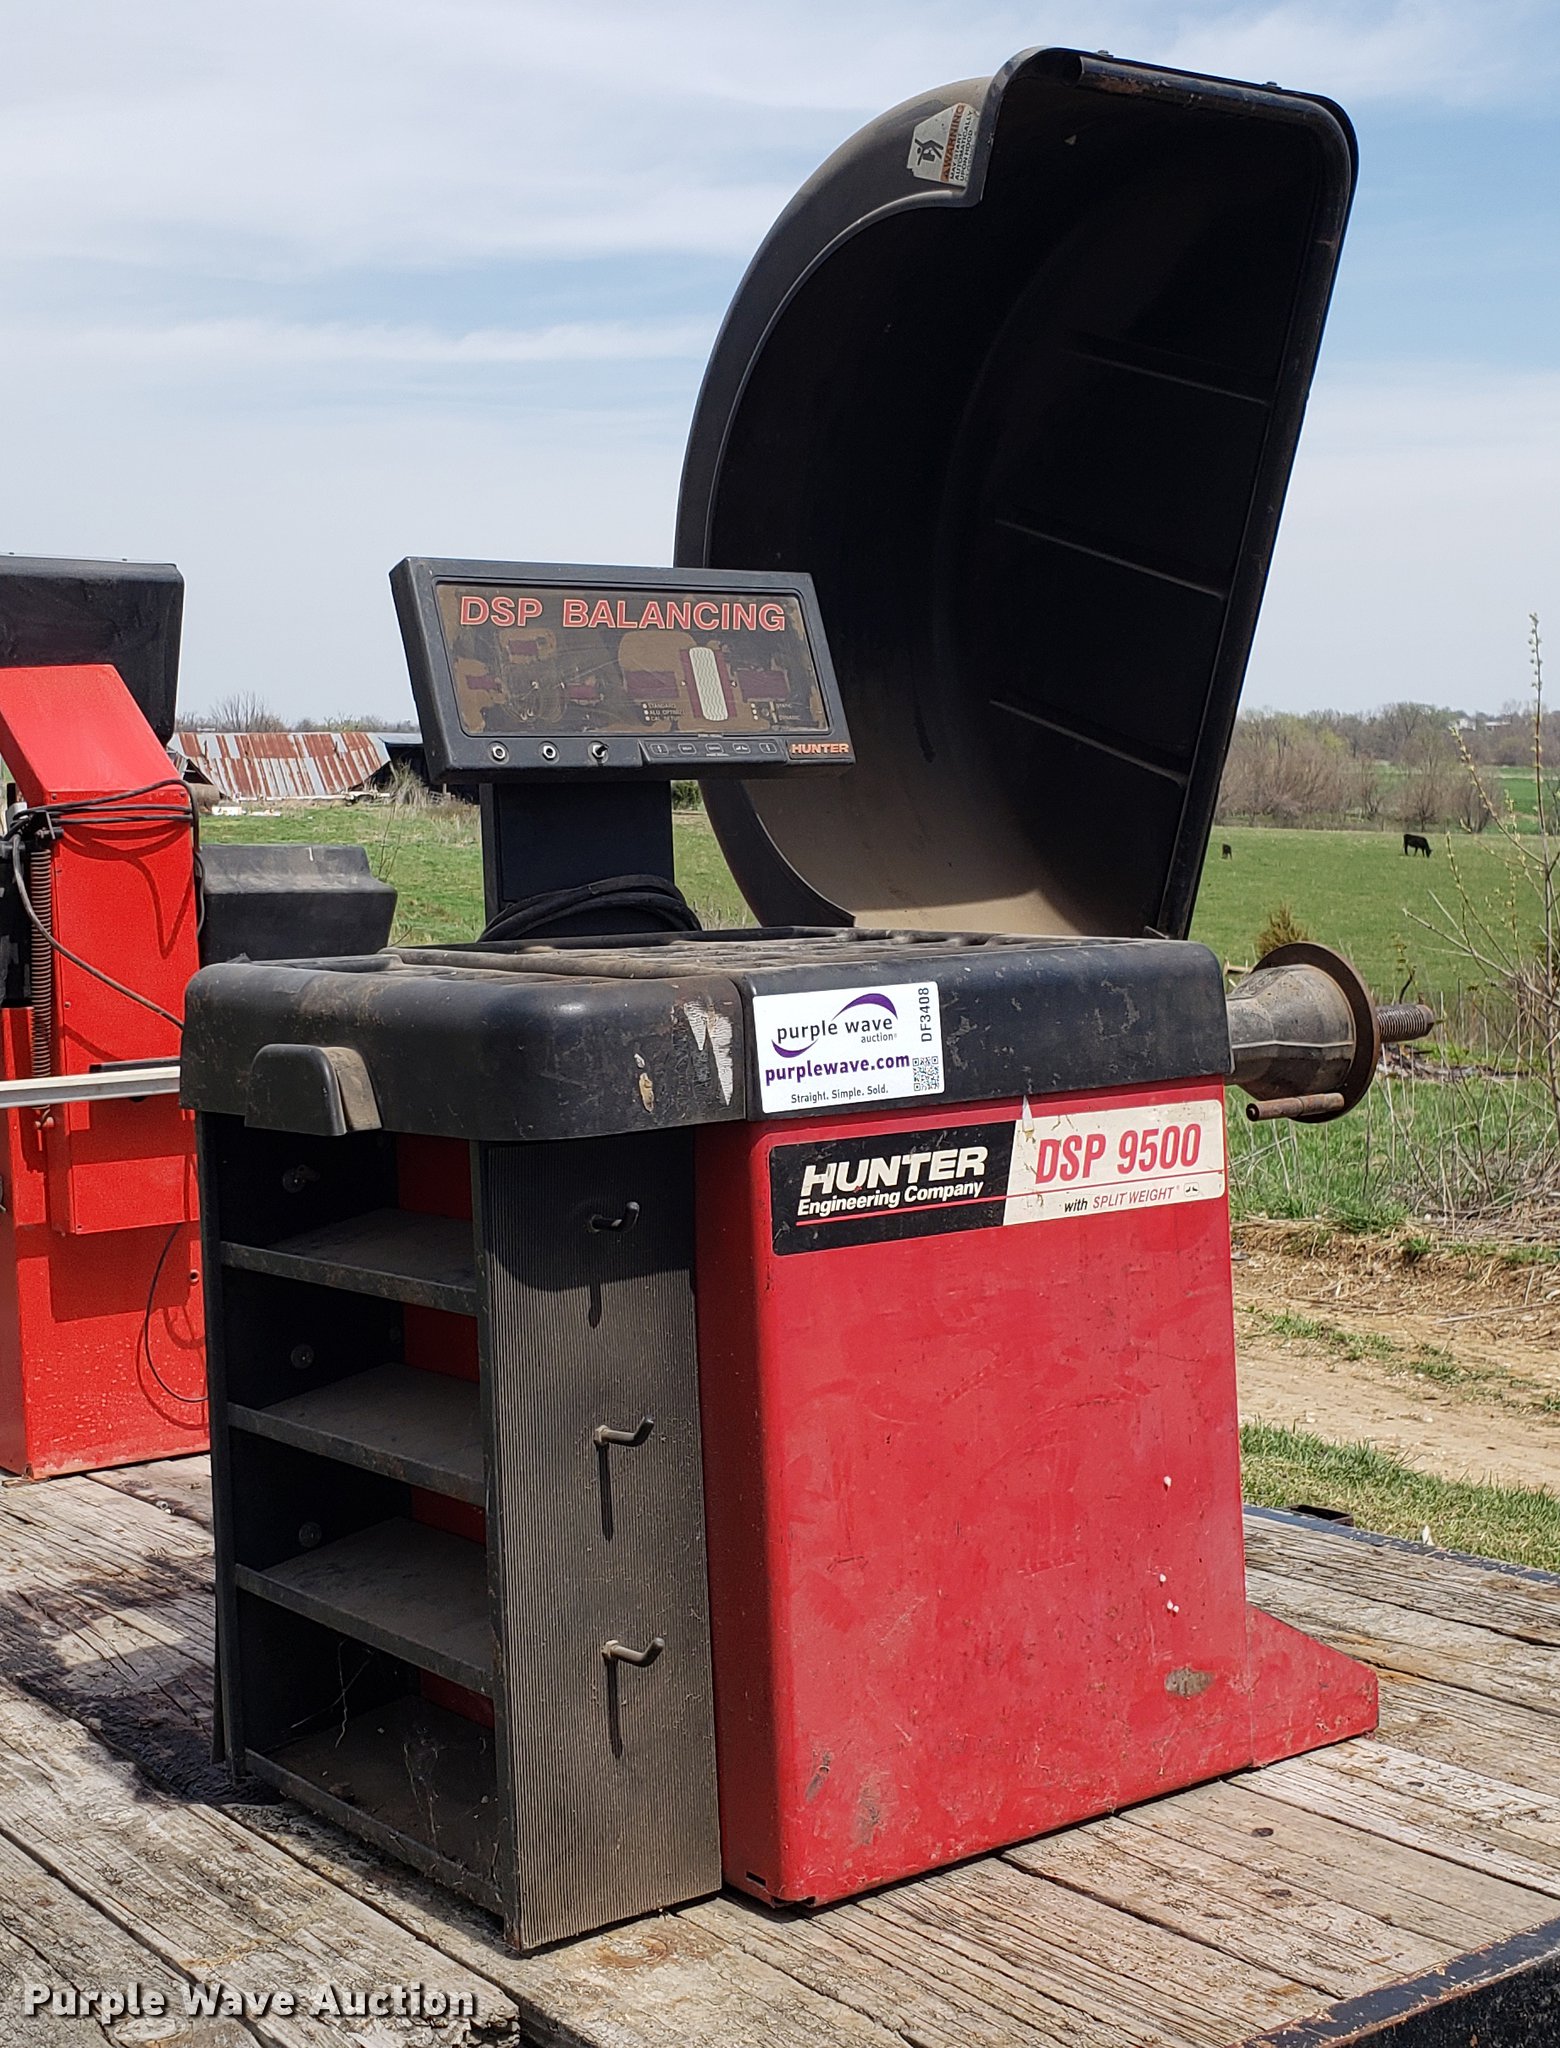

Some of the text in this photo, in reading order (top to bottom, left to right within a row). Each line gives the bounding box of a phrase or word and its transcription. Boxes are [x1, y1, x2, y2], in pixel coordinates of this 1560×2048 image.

[943, 105, 965, 170] WARNING
[955, 110, 973, 181] AUTOMATICALLY
[950, 162, 958, 180] MAY
[960, 156, 969, 181] UPON
[460, 596, 786, 631] DSP BALANCING
[791, 743, 849, 754] HUNTER
[777, 1017, 893, 1044] purple wave
[918, 987, 932, 1042] DF3408
[860, 1032, 894, 1044] auction
[765, 1054, 911, 1086] purplewave.com
[791, 1083, 889, 1104] Straight. Simple. Sold.
[1035, 1123, 1202, 1185] DSP 9500
[800, 1146, 988, 1197] HUNTER
[798, 1181, 985, 1217] Engineering Company
[1064, 1186, 1175, 1213] with SPLIT WEIGHT
